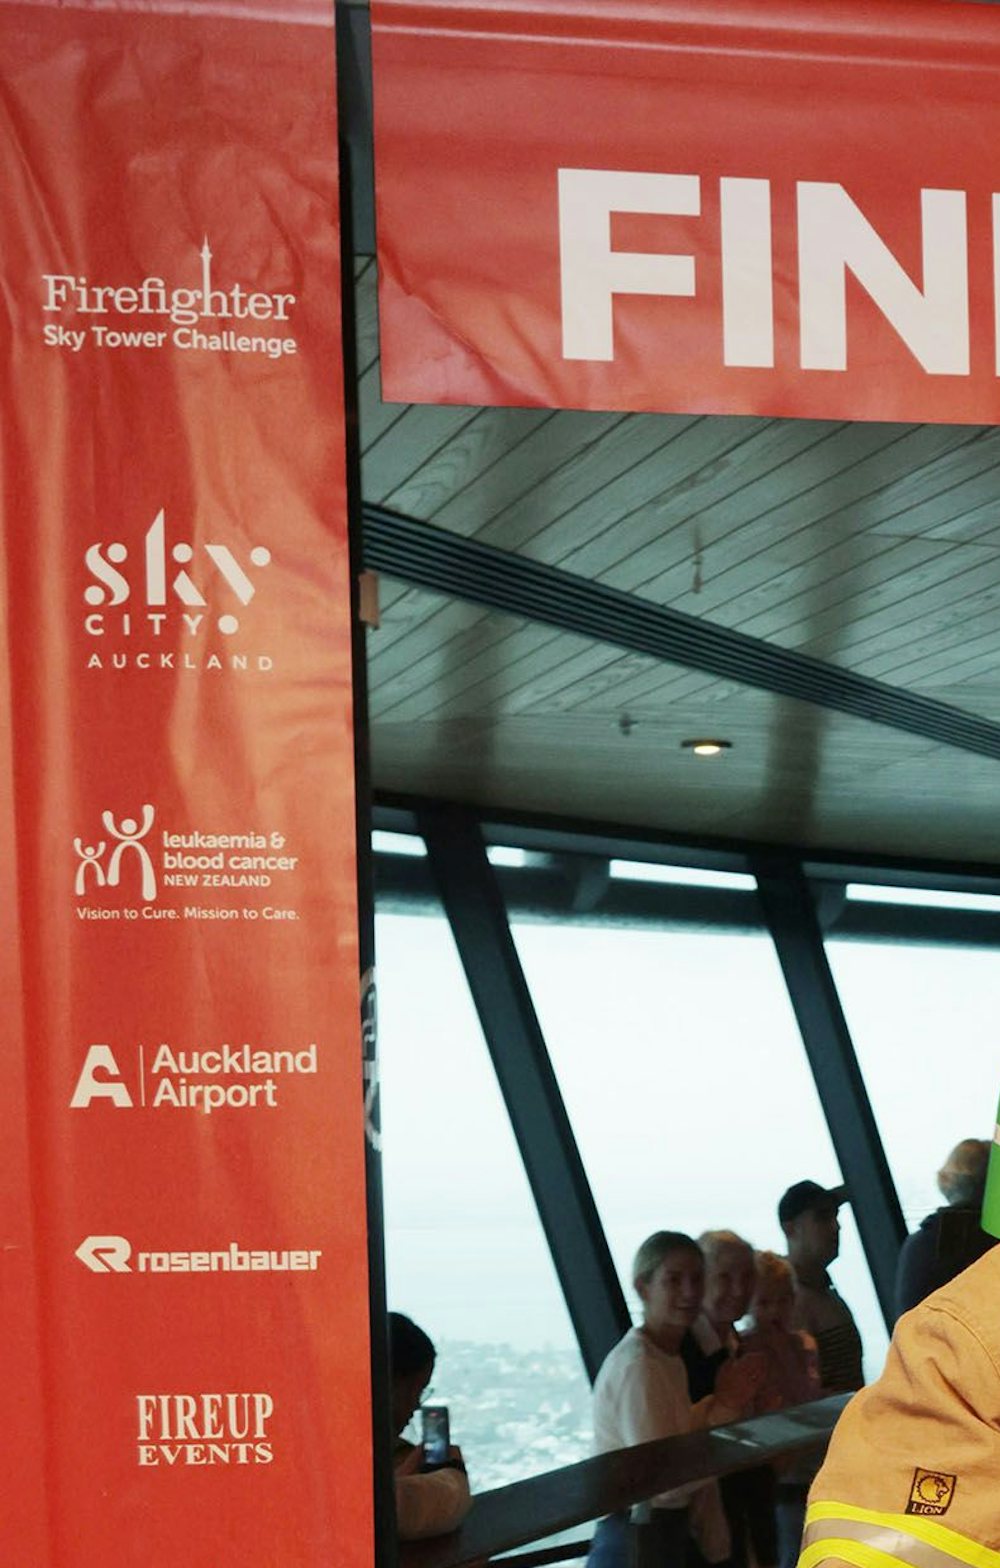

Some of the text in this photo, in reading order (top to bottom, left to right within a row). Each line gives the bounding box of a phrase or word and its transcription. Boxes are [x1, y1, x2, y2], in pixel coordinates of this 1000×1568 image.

[42, 238, 296, 326] Firefighter
[44, 324, 297, 358] Sky Tower Challenge
[84, 613, 205, 636] CITY
[87, 652, 274, 671] AUCKLAND
[163, 830, 287, 850] leukaemia &
[163, 852, 299, 871] blood cancer
[163, 874, 272, 888] NEW ZEALAND
[76, 906, 300, 920] Vision to Cure. Mission to Care.
[151, 1043, 318, 1074] Auckland
[152, 1078, 278, 1114] Airport
[138, 1242, 322, 1273] rosenbauer
[135, 1393, 275, 1441] FIREUP
[137, 1442, 275, 1467] EVENTS
[911, 1502, 943, 1514] LION
